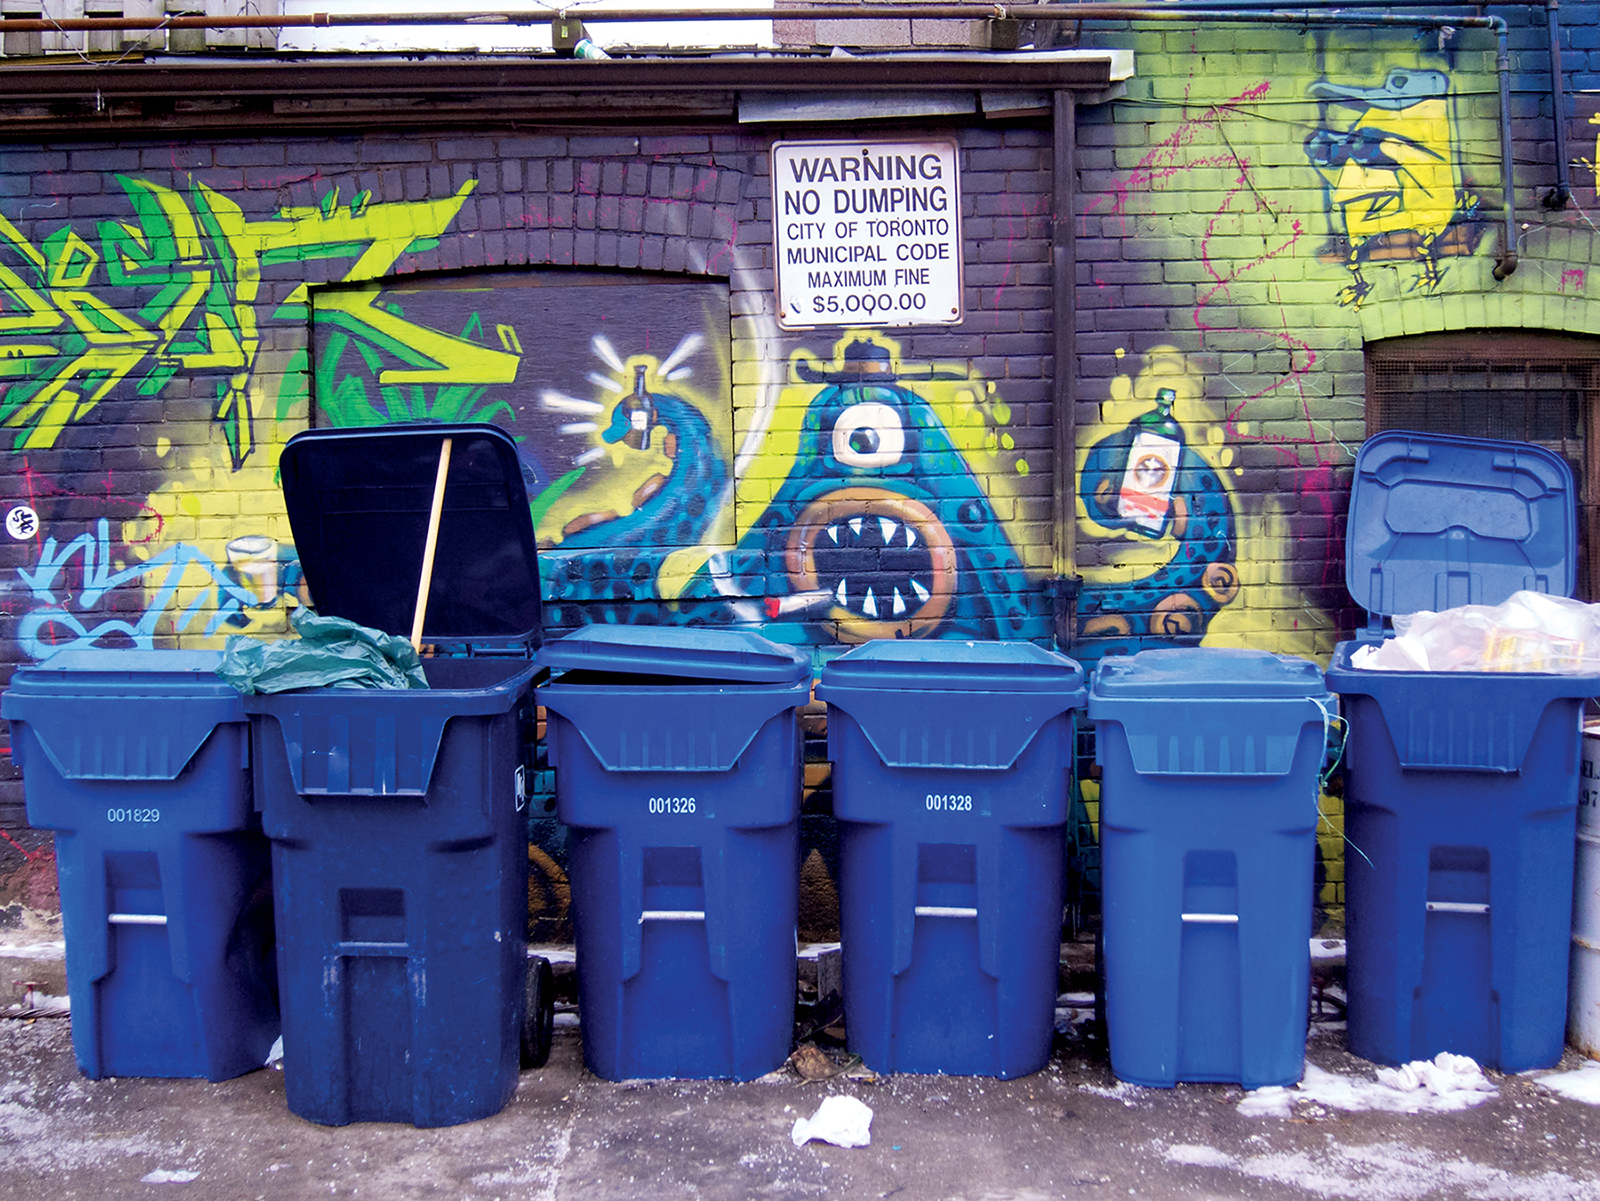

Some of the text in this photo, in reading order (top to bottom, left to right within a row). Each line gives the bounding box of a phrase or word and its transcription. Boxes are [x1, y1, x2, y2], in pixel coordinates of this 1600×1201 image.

[789, 154, 942, 183] WARNING
[784, 186, 947, 215] NO DUMPING
[787, 218, 949, 240] CITY OF TORONTO
[787, 243, 950, 264] MUNICIPAL CODE
[808, 268, 930, 288] MAXIMUM FINE
[813, 293, 926, 315] $5,000.00
[649, 797, 696, 813] 001326
[925, 794, 973, 811] 001328
[107, 808, 160, 822] 001829
